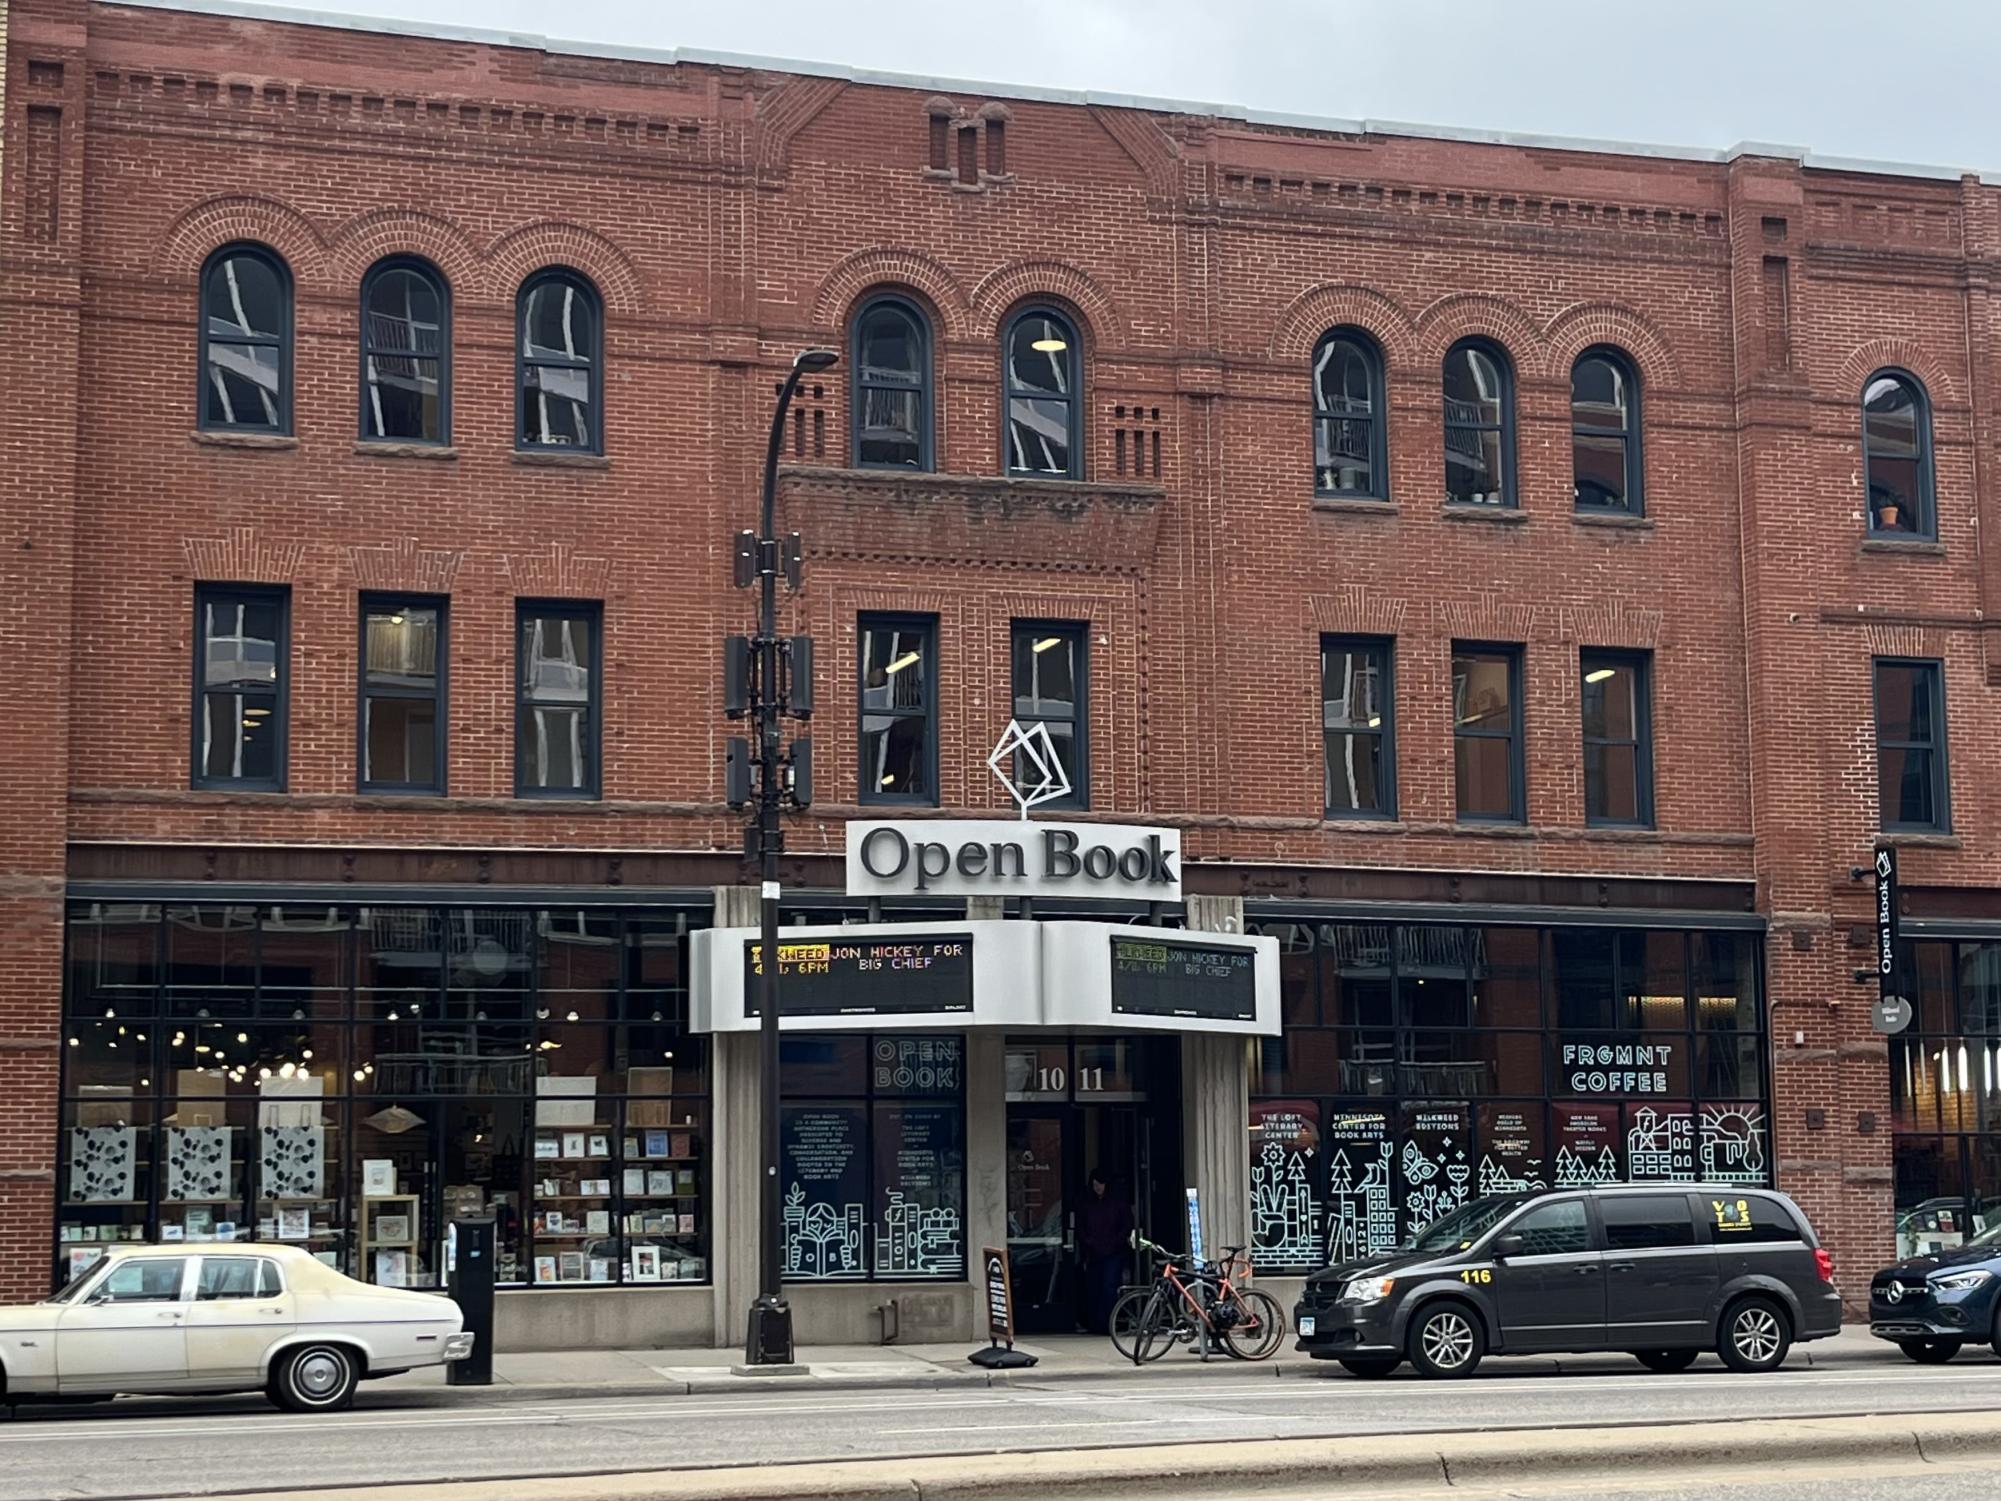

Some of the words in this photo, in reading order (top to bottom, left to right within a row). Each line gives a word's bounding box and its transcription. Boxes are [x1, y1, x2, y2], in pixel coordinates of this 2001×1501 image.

[861, 827, 1027, 890] Open
[1041, 829, 1178, 883] Book
[1879, 880, 1889, 924] Book
[831, 947, 860, 959] JON
[870, 945, 923, 958] HICKEY
[933, 944, 963, 957] FOR
[1168, 953, 1186, 963] JON
[1231, 956, 1248, 968] FOR
[1881, 928, 1893, 974] Open
[798, 961, 828, 974] 6PM
[859, 959, 881, 970] BIG
[892, 957, 931, 970] CHIEF
[1186, 963, 1200, 975] BIG
[1206, 966, 1232, 977] CHIEF
[875, 1040, 956, 1062] OPEN
[1563, 1045, 1672, 1066] FRGMNT
[875, 1067, 954, 1088] BOOK
[1039, 1067, 1065, 1091] 10
[1080, 1067, 1104, 1091] 11
[1571, 1071, 1667, 1092] COFFEE
[1261, 1113, 1277, 1121] THE
[1281, 1113, 1301, 1121] LOFT
[1461, 1269, 1491, 1284] 116
